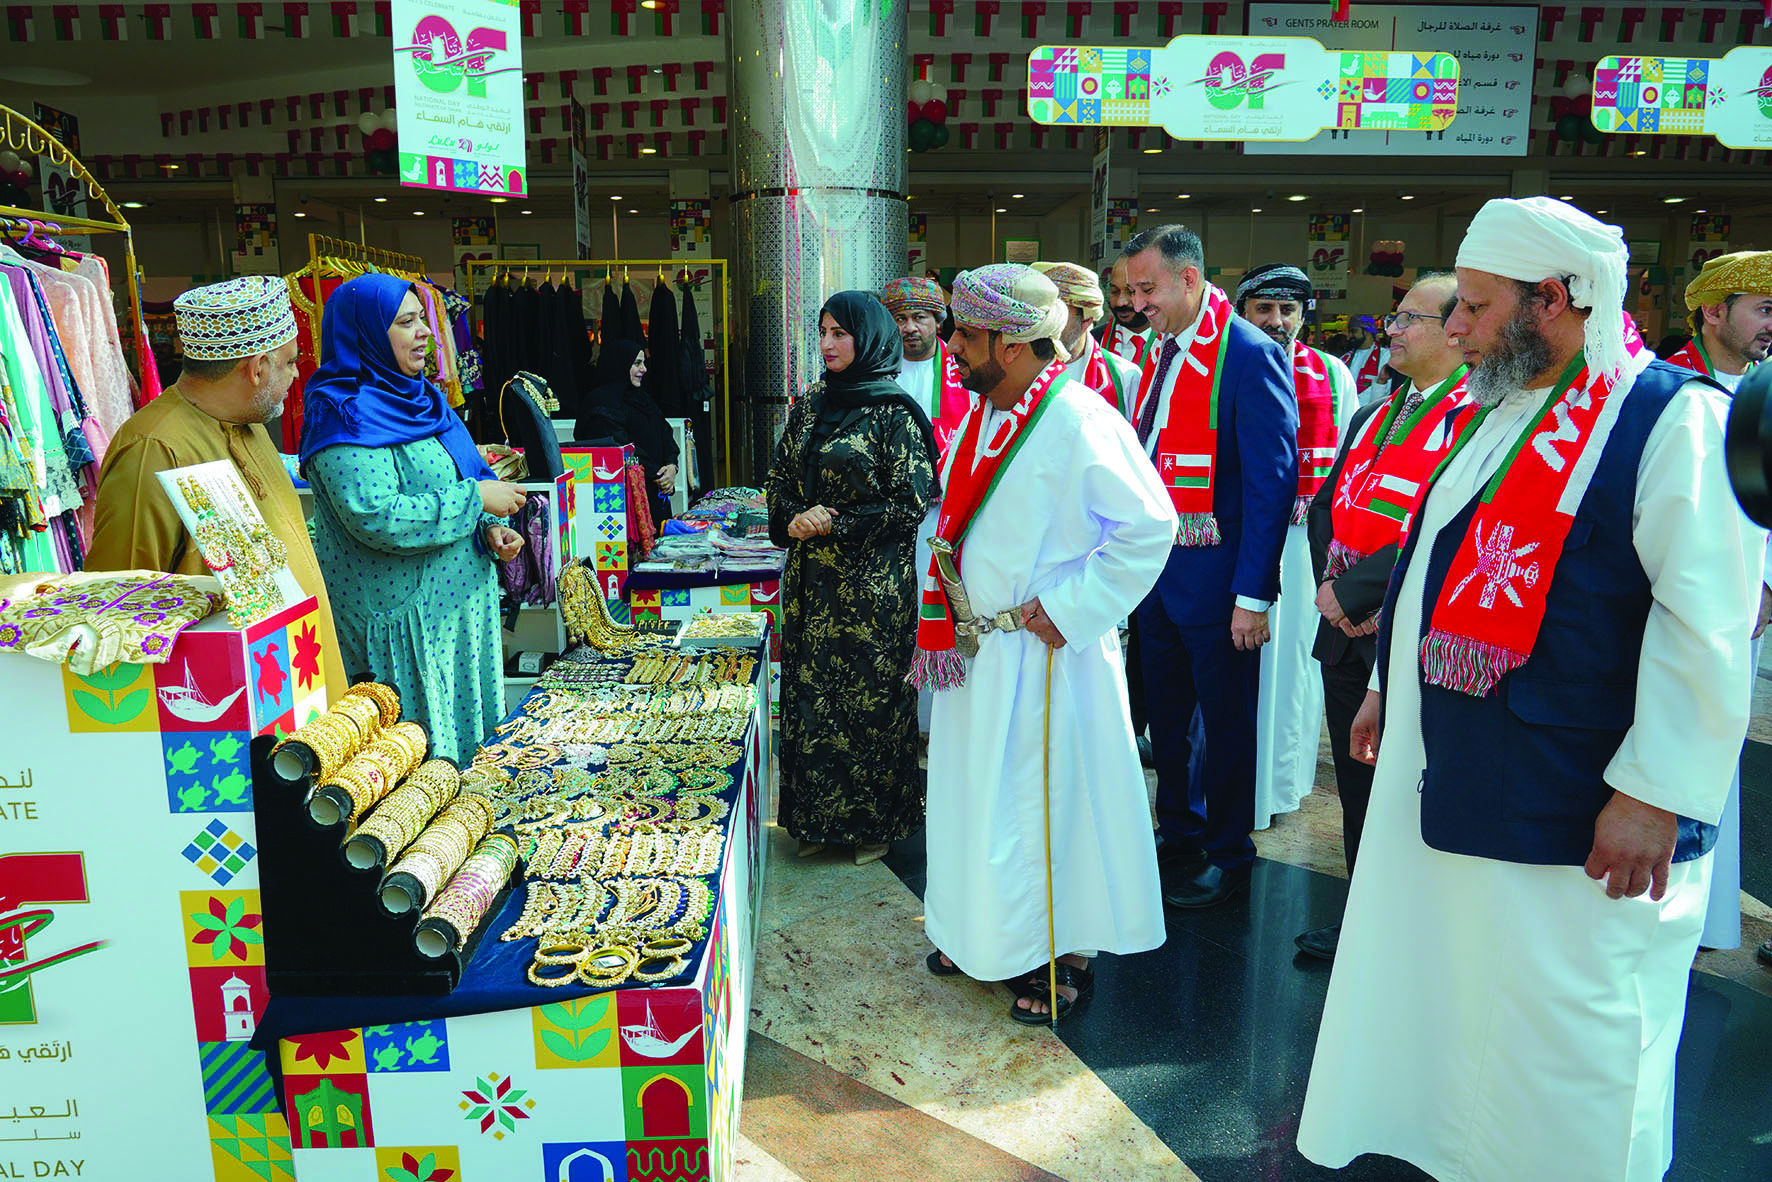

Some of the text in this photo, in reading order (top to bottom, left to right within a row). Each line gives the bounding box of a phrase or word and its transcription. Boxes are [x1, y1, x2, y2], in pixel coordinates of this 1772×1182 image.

[1285, 18, 1379, 29] GENTS PRAYER ROOM
[1417, 21, 1502, 33] غرفة الصلاة للرجال
[1483, 51, 1500, 61] دورة
[1473, 78, 1498, 90] قسم
[1474, 106, 1496, 117] غرفة
[1477, 133, 1494, 144] دورة
[33, 1159, 85, 1177] DAY
